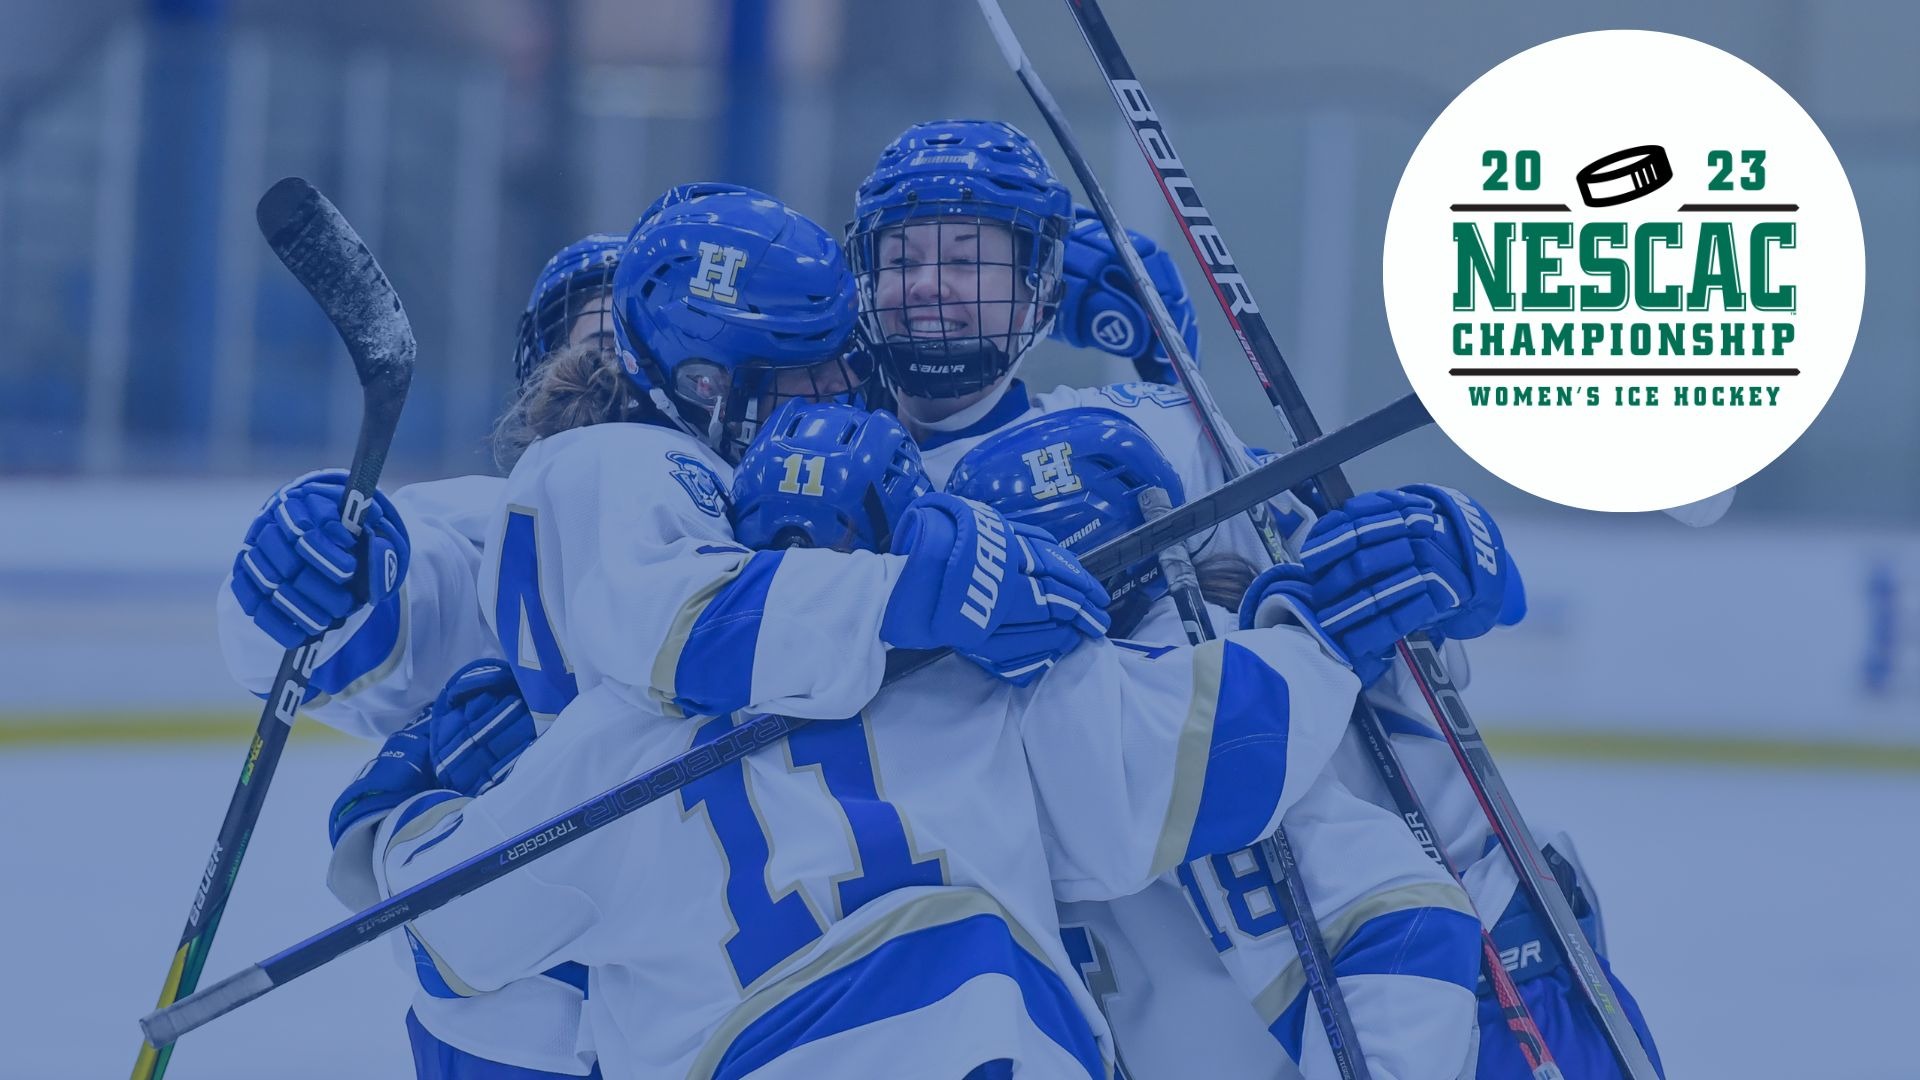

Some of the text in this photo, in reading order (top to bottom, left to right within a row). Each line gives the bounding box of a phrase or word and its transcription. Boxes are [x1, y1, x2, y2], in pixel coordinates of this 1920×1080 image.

[688, 241, 748, 305] H
[778, 453, 827, 497] 11
[1021, 441, 1083, 501] H
[494, 504, 579, 721] 4
[676, 711, 948, 994] 11
[1176, 846, 1290, 957] 18
